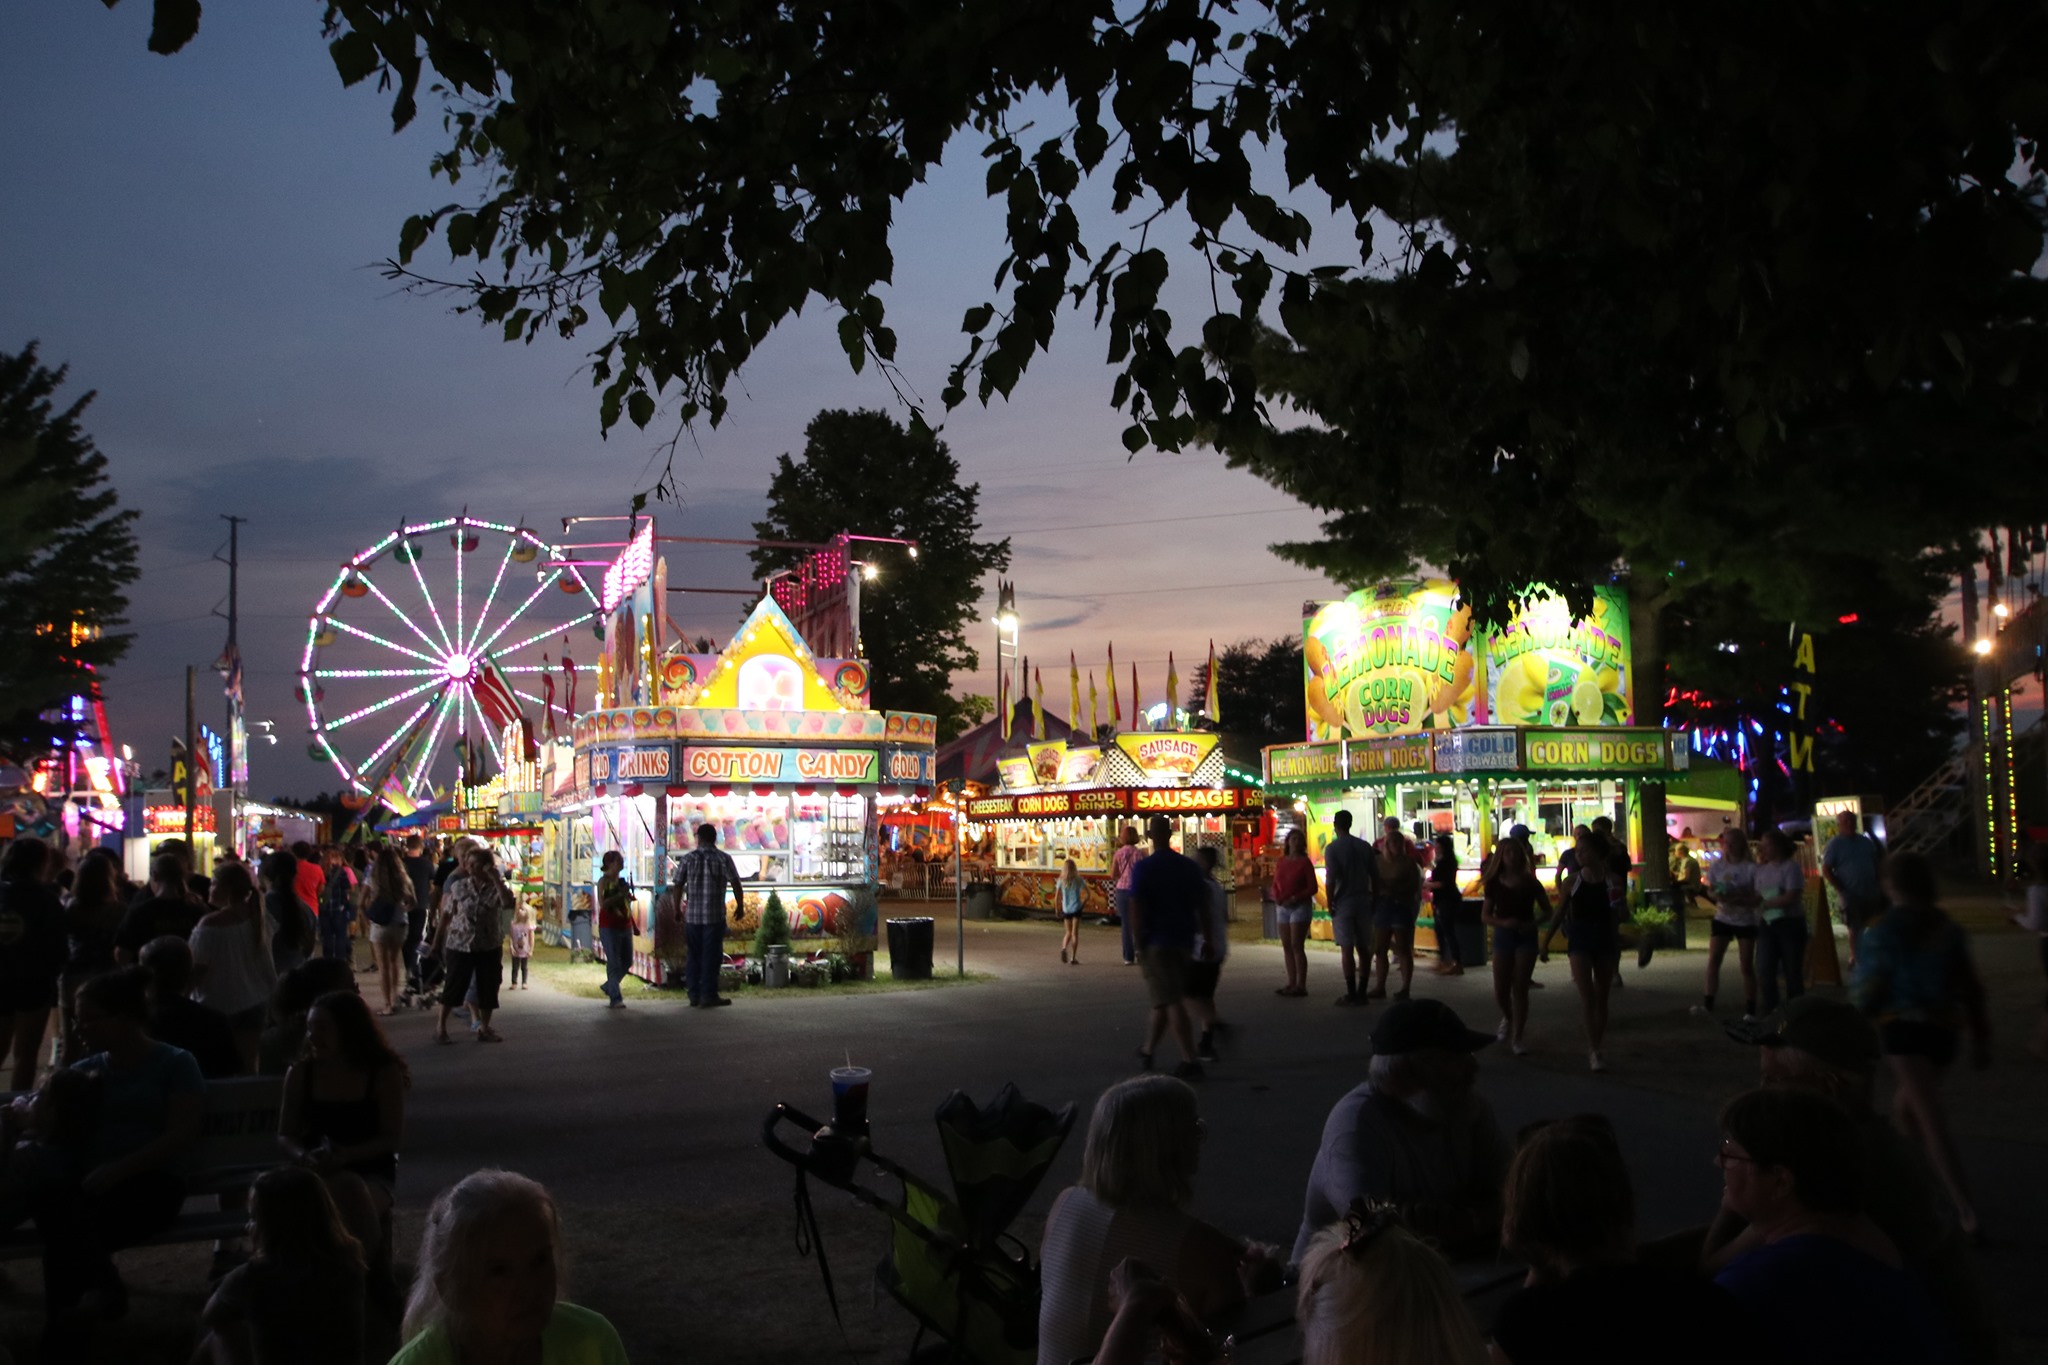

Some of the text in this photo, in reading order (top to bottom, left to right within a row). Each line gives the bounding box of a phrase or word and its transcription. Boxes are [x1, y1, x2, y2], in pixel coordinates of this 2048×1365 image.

[1488, 618, 1622, 671] LEMONADE
[1321, 625, 1459, 702] LEMONADE
[1359, 678, 1412, 707] CORN
[1362, 701, 1411, 728] DOGS
[1139, 739, 1198, 758] SAUSAGE
[1468, 735, 1515, 754] COLD
[1531, 740, 1590, 765] CORN
[1601, 741, 1659, 765] DOGS
[618, 750, 669, 778] DRINKS
[690, 751, 874, 779] COTTON CANDY
[891, 753, 920, 779] COLD
[1274, 753, 1337, 778] LEMONADE
[1352, 746, 1426, 773] CORN DOGS
[1481, 754, 1515, 768] WATER
[969, 798, 1014, 815] CHEESESTEAK
[1018, 795, 1069, 814] CORN DOGS
[1074, 800, 1125, 811] DRINKS
[1079, 792, 1116, 802] COLD
[1137, 789, 1234, 808] SAUSAGE
